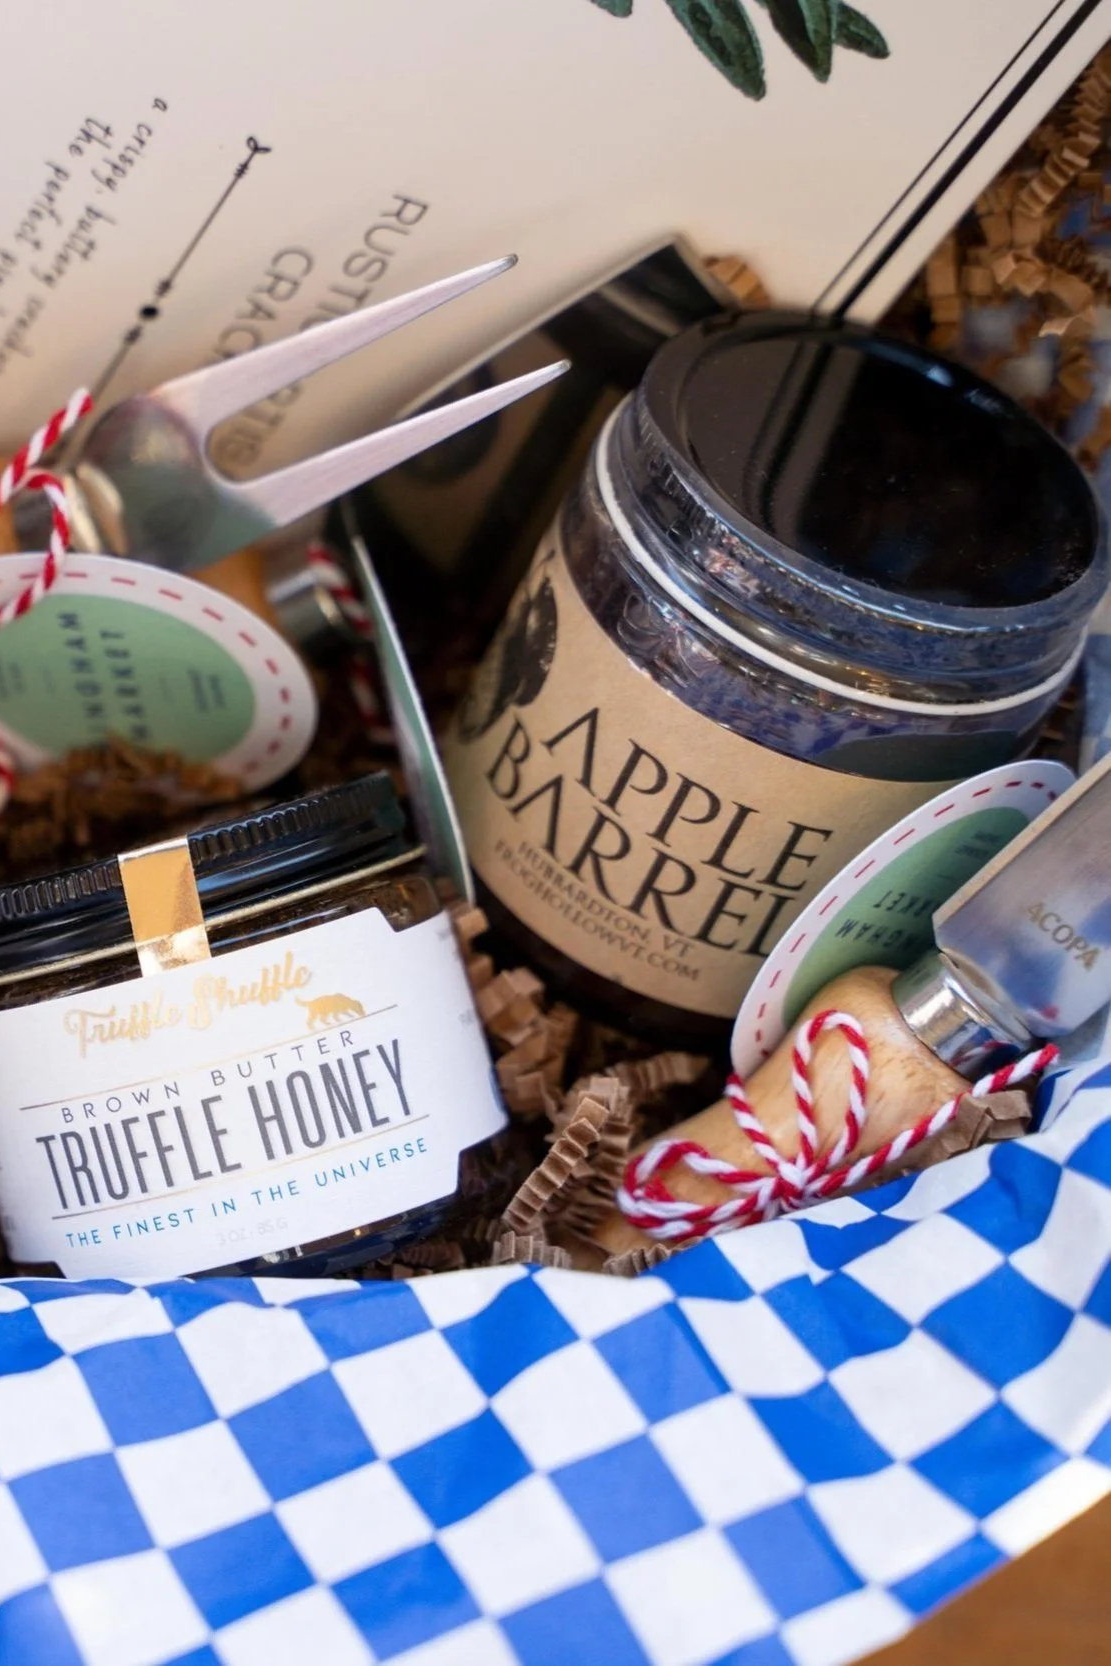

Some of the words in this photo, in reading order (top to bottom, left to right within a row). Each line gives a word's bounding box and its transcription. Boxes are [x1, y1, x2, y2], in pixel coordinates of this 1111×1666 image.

[68, 117, 115, 158] the
[151, 96, 169, 113] a
[13, 159, 71, 252] perfect
[29, 203, 118, 290] buttery
[214, 246, 313, 359] CRAC
[484, 712, 797, 960] BARREL
[541, 706, 835, 893] APPLE
[661, 934, 696, 960] VT
[1021, 902, 1101, 972] ACOPA
[63, 988, 183, 1060] Truffle
[187, 948, 314, 1031] Shuffle
[60, 1079, 181, 1124] BROWN
[211, 1029, 355, 1088] BUTTER
[35, 1094, 243, 1211] TRUFFLE
[247, 1038, 416, 1161] HONEY
[65, 1226, 109, 1249] THE
[112, 1207, 197, 1239] FINEST
[211, 1197, 237, 1218] IN
[249, 1179, 301, 1206] THE
[314, 1136, 429, 1188] UNIVERSE
